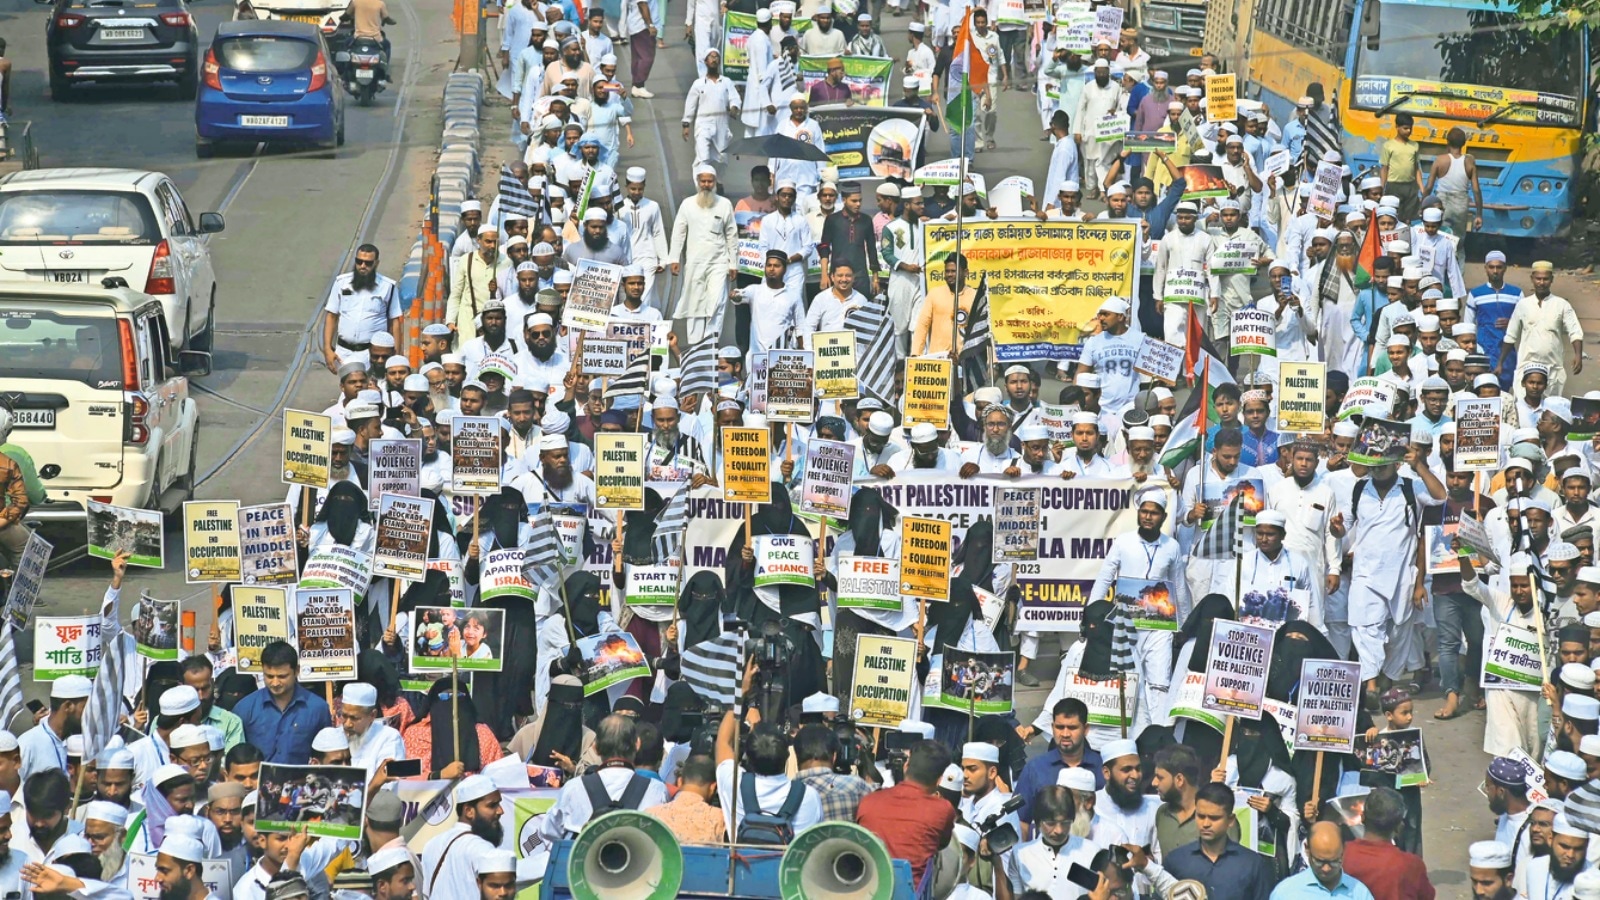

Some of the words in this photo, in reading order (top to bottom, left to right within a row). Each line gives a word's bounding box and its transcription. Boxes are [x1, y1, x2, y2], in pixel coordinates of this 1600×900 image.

[974, 228, 994, 242] রাজ্য
[997, 224, 1033, 241] জমিয়ত
[1035, 224, 1074, 241] উলামায়ে
[1076, 225, 1107, 242] হিন্দের
[1110, 230, 1132, 242] ডাকে
[1381, 232, 1399, 243] REE
[1018, 248, 1073, 262] রাজাবাজার
[1076, 248, 1105, 267] চলুন
[54, 271, 82, 282] WB02A
[1235, 312, 1270, 323] BOYCOTT
[613, 325, 645, 336] PEACE
[1232, 324, 1274, 336] APARTHEID
[627, 340, 645, 349] THE
[1236, 335, 1267, 346] ISRAEL
[583, 344, 596, 354] SAVE
[597, 346, 624, 355] PALESTINE
[818, 346, 850, 357] PALESTINE
[1098, 348, 1140, 360] LEGEND
[584, 358, 603, 367] SAVE
[604, 359, 624, 369] GAZA
[914, 363, 942, 373] JUSTICE
[1104, 359, 1132, 377] 89
[913, 377, 947, 386] FREEDOM
[1285, 377, 1319, 389] PALESTINE
[912, 390, 946, 400] EQUALITY
[919, 403, 944, 411] PALESTINE
[1280, 401, 1322, 412] OCCUPATION
[303, 419, 313, 427] FREE
[291, 427, 325, 442] PALESTINE
[731, 432, 759, 442] JUSTICE
[382, 446, 397, 454] STOP
[731, 447, 767, 457] FREEDOM
[819, 446, 833, 456] STOP
[833, 448, 845, 458] THE
[286, 450, 328, 467] OCCUPATION
[376, 456, 415, 468] VOILENCE
[602, 451, 638, 462] PALESTINE
[732, 462, 767, 472] EQUALITY
[812, 458, 849, 474] VOILENCE
[373, 470, 387, 479] FREE
[388, 470, 417, 479] PALESTINE
[728, 475, 737, 483] FOR
[738, 475, 766, 483] PALESTINE
[807, 471, 821, 481] FREE
[822, 473, 849, 485] PALESTINE
[599, 476, 641, 487] OCCUPATION
[906, 483, 990, 507] PALESTINE
[1041, 487, 1131, 511] CCUPATION
[1003, 491, 1035, 501] PEACE
[393, 501, 407, 509] END
[410, 503, 421, 511] THE
[1001, 506, 1012, 516] IN
[1017, 506, 1035, 516] THE
[246, 509, 284, 523] PEACE
[193, 520, 233, 532] PALESTINE
[563, 521, 578, 529] WAR
[911, 522, 941, 535] JUSTICE
[998, 521, 1037, 530] MIDDLE
[246, 527, 260, 539] IN
[264, 525, 287, 537] THE
[385, 530, 421, 541] PALESTINE
[209, 536, 218, 544] END
[771, 538, 796, 547] GIVE
[910, 538, 948, 551] FREEDOM
[1005, 536, 1028, 546] EAST
[30, 542, 47, 560] PEACE
[190, 545, 238, 558] OCCUPATION
[245, 540, 292, 555] MIDDLE
[490, 552, 524, 564] BOYCO
[768, 551, 800, 560] PEACE
[910, 554, 947, 567] EQUALITY
[256, 558, 284, 570] EAST
[759, 566, 766, 574] A
[768, 564, 809, 575] CHANCE
[853, 561, 890, 575] FREE
[633, 573, 667, 581] START
[904, 567, 916, 575] FOR
[917, 568, 945, 579] PALESTINE
[15, 591, 29, 609] EAST
[255, 596, 266, 604] FREE
[309, 596, 324, 604] END
[325, 596, 339, 604] THE
[242, 606, 280, 620] PALESTINE
[305, 606, 344, 615] BLOCKADE
[302, 617, 325, 626] STAND
[328, 618, 348, 626] WITH
[258, 624, 267, 632] END
[306, 628, 345, 637] PALESTINE
[56, 625, 83, 643] যুদ্ধ
[1228, 630, 1245, 641] STOP
[1246, 634, 1259, 645] THE
[46, 646, 82, 664] শান্তি
[301, 650, 322, 658] GAZA
[324, 648, 353, 657] PEOPLE
[880, 646, 893, 656] FREE
[1218, 642, 1264, 664] VOILENCE
[1493, 648, 1508, 663] পূর্ণ
[864, 656, 907, 673] PALESTINE
[1213, 659, 1229, 672] FREE
[1230, 663, 1264, 678] PALESTINE
[878, 675, 889, 684] END
[1316, 668, 1333, 678] STOP
[1335, 670, 1347, 680] THE
[856, 684, 908, 703] OCCUPATION
[1308, 681, 1353, 698] VOILENCE
[1303, 699, 1318, 710] FREE
[1320, 700, 1353, 712] PALESTINE
[1279, 708, 1294, 719] THE
